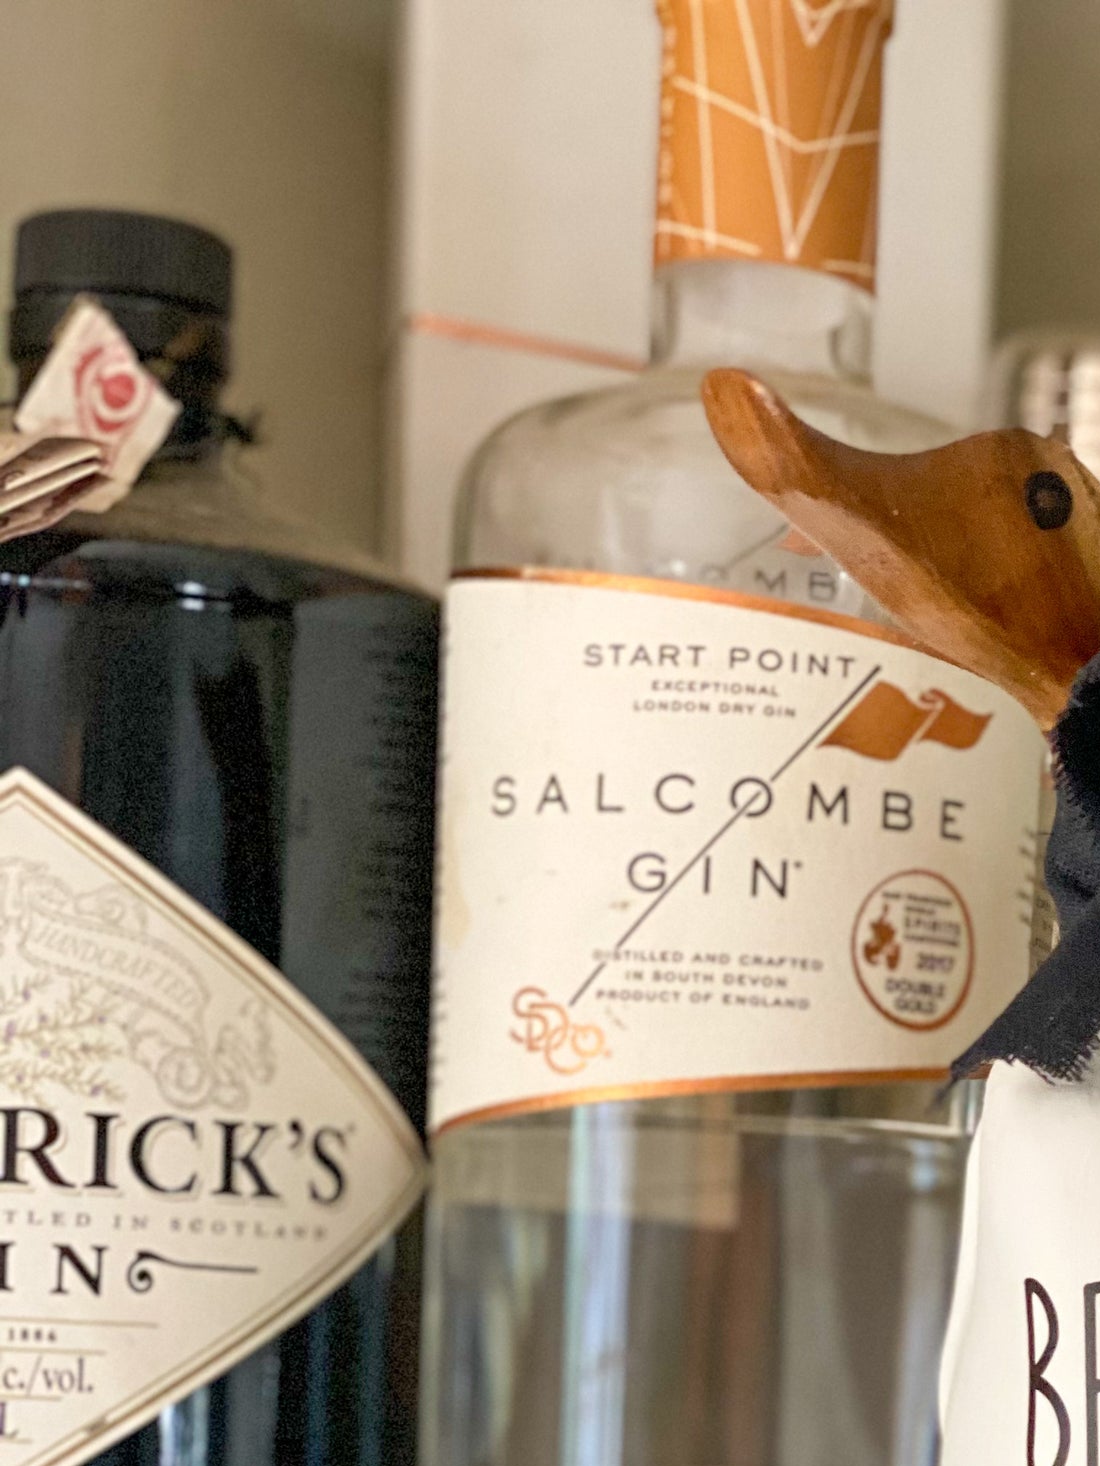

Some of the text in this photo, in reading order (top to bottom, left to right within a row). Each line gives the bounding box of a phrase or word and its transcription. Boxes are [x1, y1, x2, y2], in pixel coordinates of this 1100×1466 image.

[583, 644, 856, 678] START POINT
[651, 679, 779, 697] EXCEPTIONAL
[633, 700, 797, 718] LONDON DRY GIN
[491, 773, 965, 841] SALCOMBE
[626, 852, 790, 898] GIN
[591, 949, 824, 972] DISTILLED AND CRAFTED
[624, 970, 788, 988] IN SOUTH DEVON
[595, 989, 811, 1011] PRODUCT OF ENGLAND
[113, 1215, 148, 1230] IN
[170, 1219, 328, 1241] SCOTLAND
